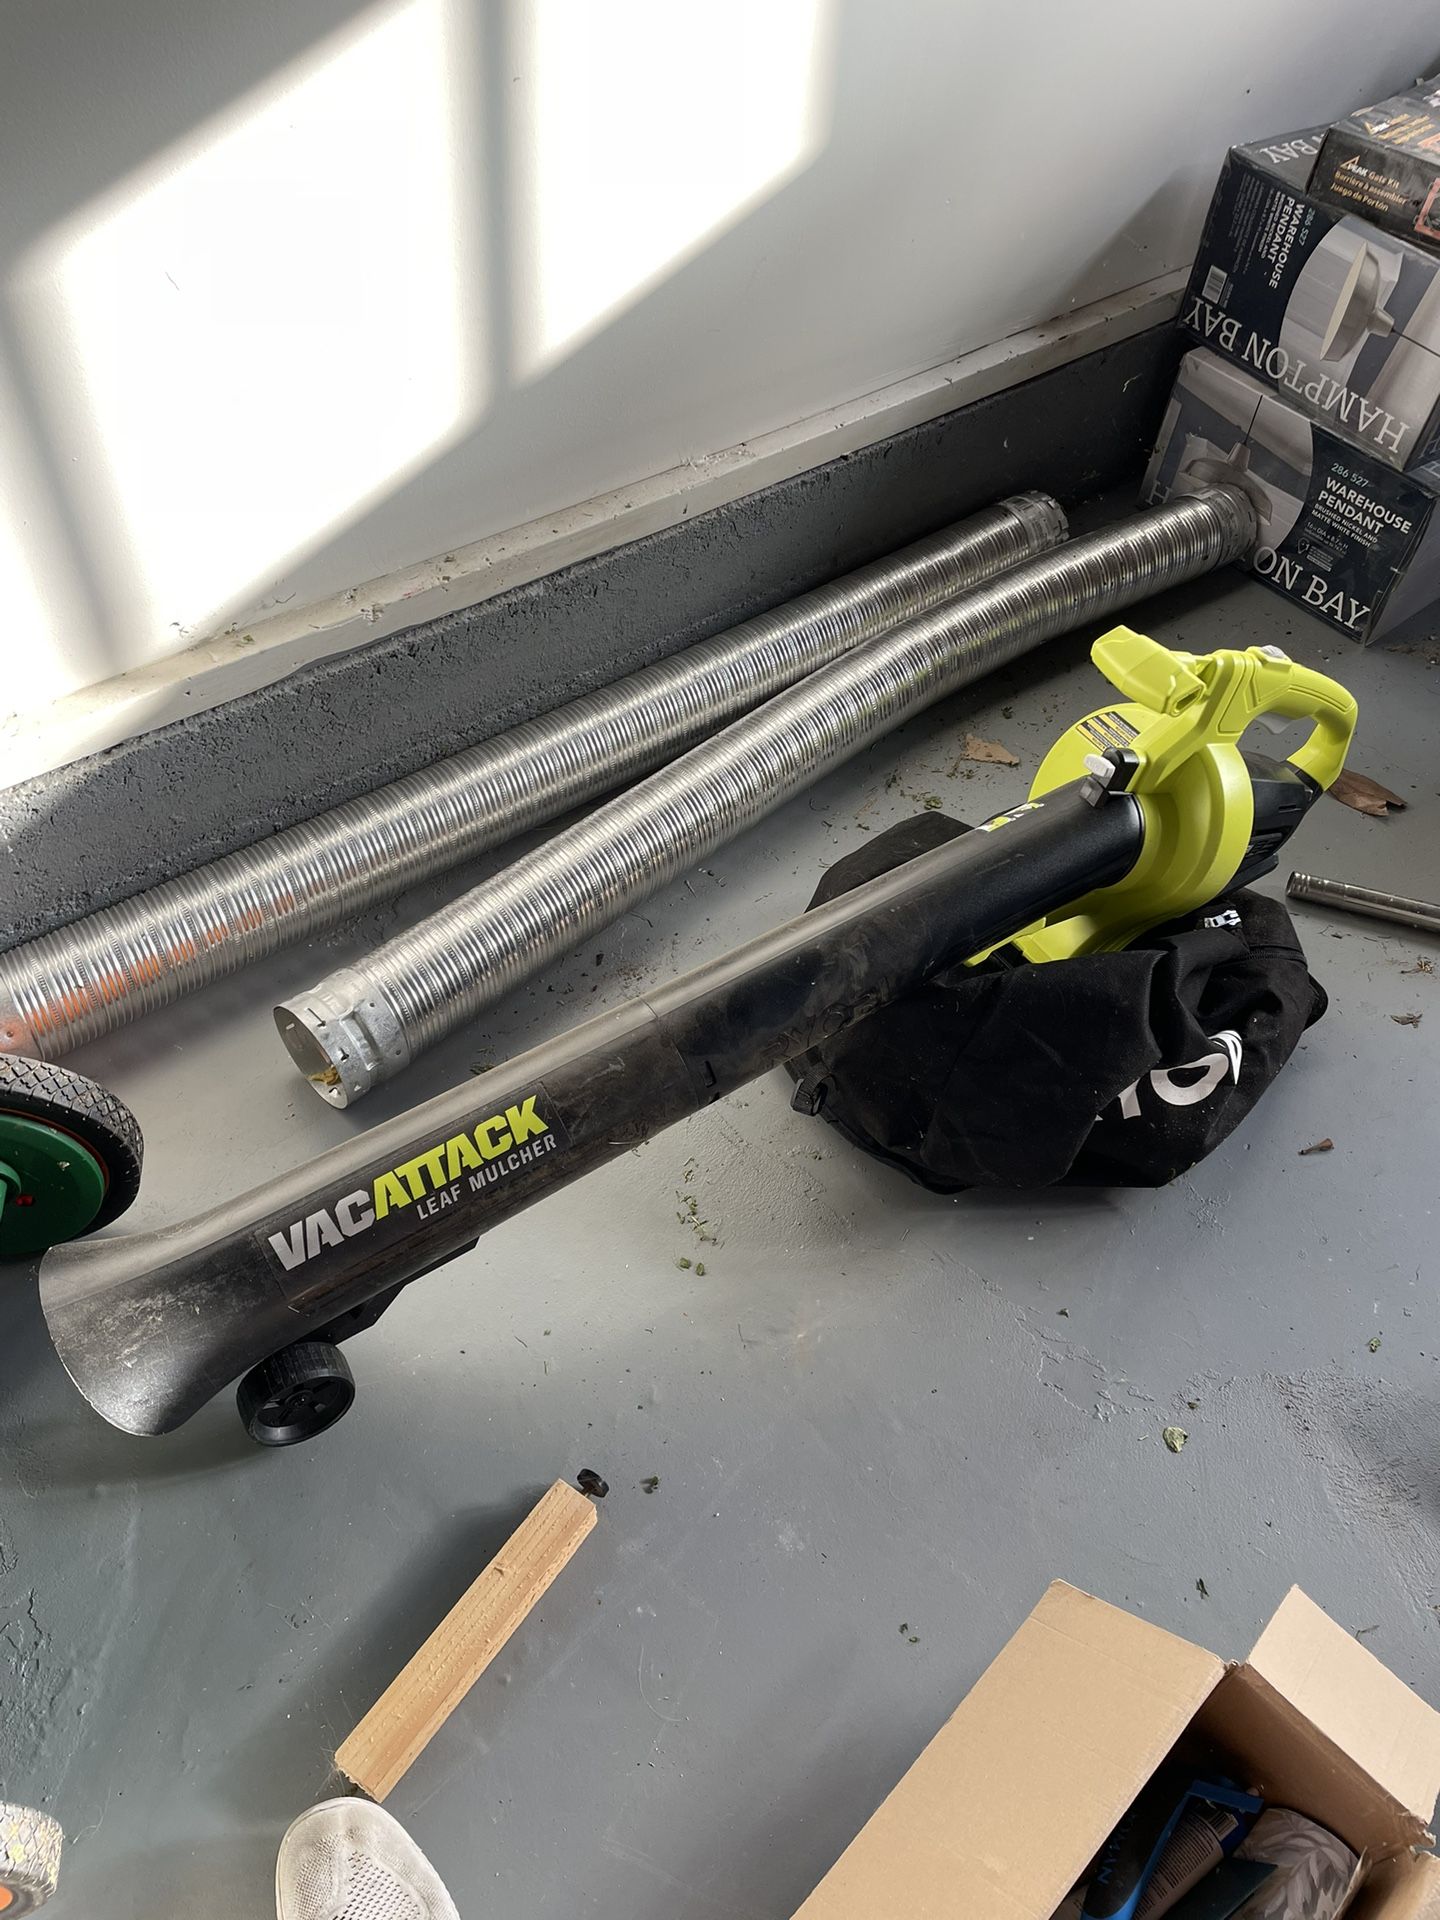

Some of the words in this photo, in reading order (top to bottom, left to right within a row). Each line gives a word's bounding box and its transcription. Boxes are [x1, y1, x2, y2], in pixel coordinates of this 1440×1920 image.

[1260, 139, 1319, 164] BAY
[1330, 182, 1352, 197] Juego
[1352, 191, 1363, 201] de
[1347, 164, 1369, 178] PEAK
[1368, 170, 1388, 183] Gate
[1387, 177, 1400, 189] Kit
[1267, 196, 1296, 263] PENDANT
[1268, 203, 1305, 289] WAREHOUSE
[1299, 227, 1309, 246] 527
[1183, 297, 1243, 353] BAY
[1241, 331, 1411, 454] HAMPTON
[1331, 462, 1349, 478] 286
[1350, 473, 1369, 488] 527
[1311, 509, 1331, 525] MATTE
[1332, 520, 1351, 536] WHITE
[1350, 532, 1372, 548] FINISH
[1314, 503, 1341, 522] BRUSHED
[1341, 519, 1363, 536] NICKEL
[1363, 532, 1378, 544] AND
[1318, 490, 1384, 534] PENDANT
[1326, 476, 1412, 534] WAREHOUSE
[1301, 574, 1371, 629] BAY
[267, 1094, 549, 1271] VACATTACK
[415, 1183, 461, 1221] LEAF
[467, 1133, 557, 1193] MULCHER
